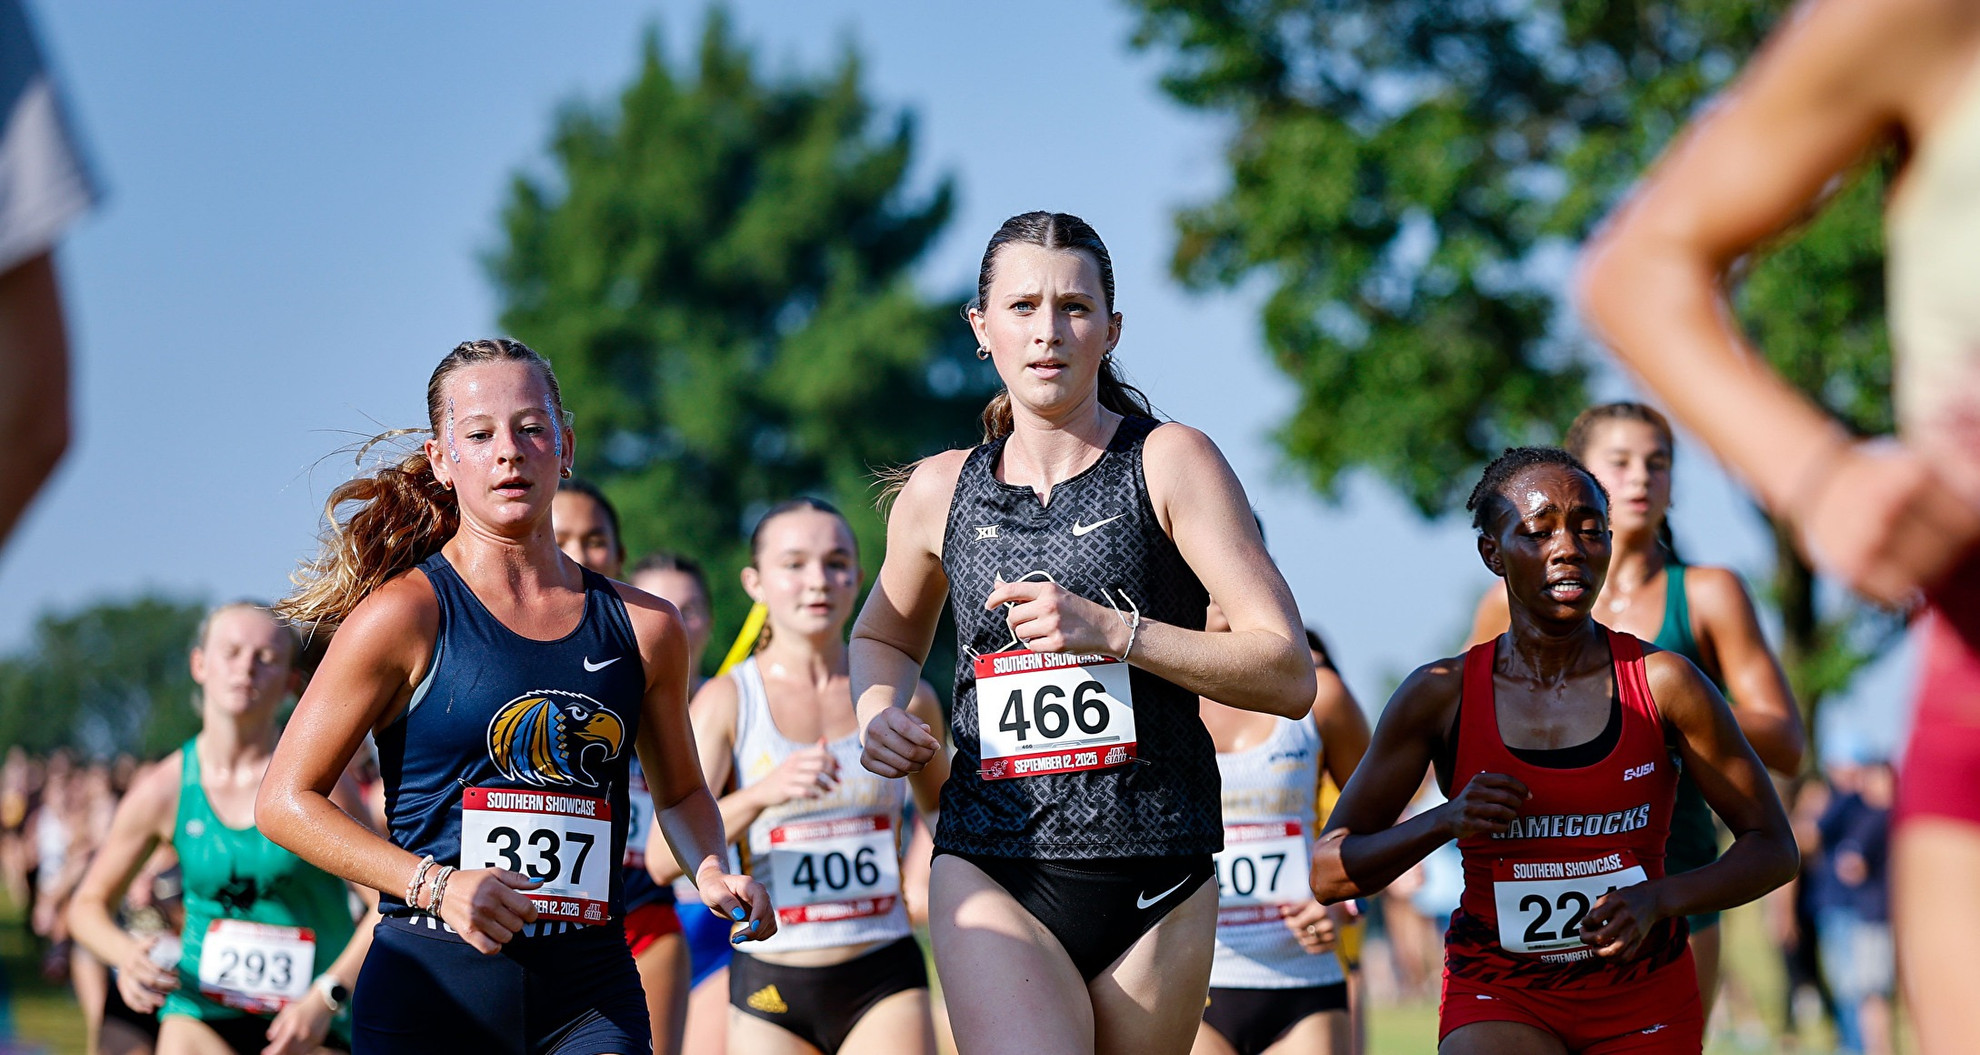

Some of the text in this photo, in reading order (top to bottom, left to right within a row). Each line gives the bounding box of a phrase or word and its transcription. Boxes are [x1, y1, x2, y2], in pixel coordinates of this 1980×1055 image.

[993, 653, 1043, 674] SOUTHERN
[998, 680, 1110, 741] 466
[1014, 752, 1098, 774] SEPTEMBER 12, 2025
[487, 791, 596, 817] SOUTHERN SHOWCASE
[1491, 803, 1651, 840] AMECOCKS
[485, 826, 595, 885] 337
[792, 847, 880, 893] 406
[1513, 853, 1623, 879] SOUTHERN SHOWCASE
[549, 901, 560, 915] 12,
[560, 902, 579, 917] 2025
[1519, 886, 1618, 943] 22
[217, 946, 292, 989] 293
